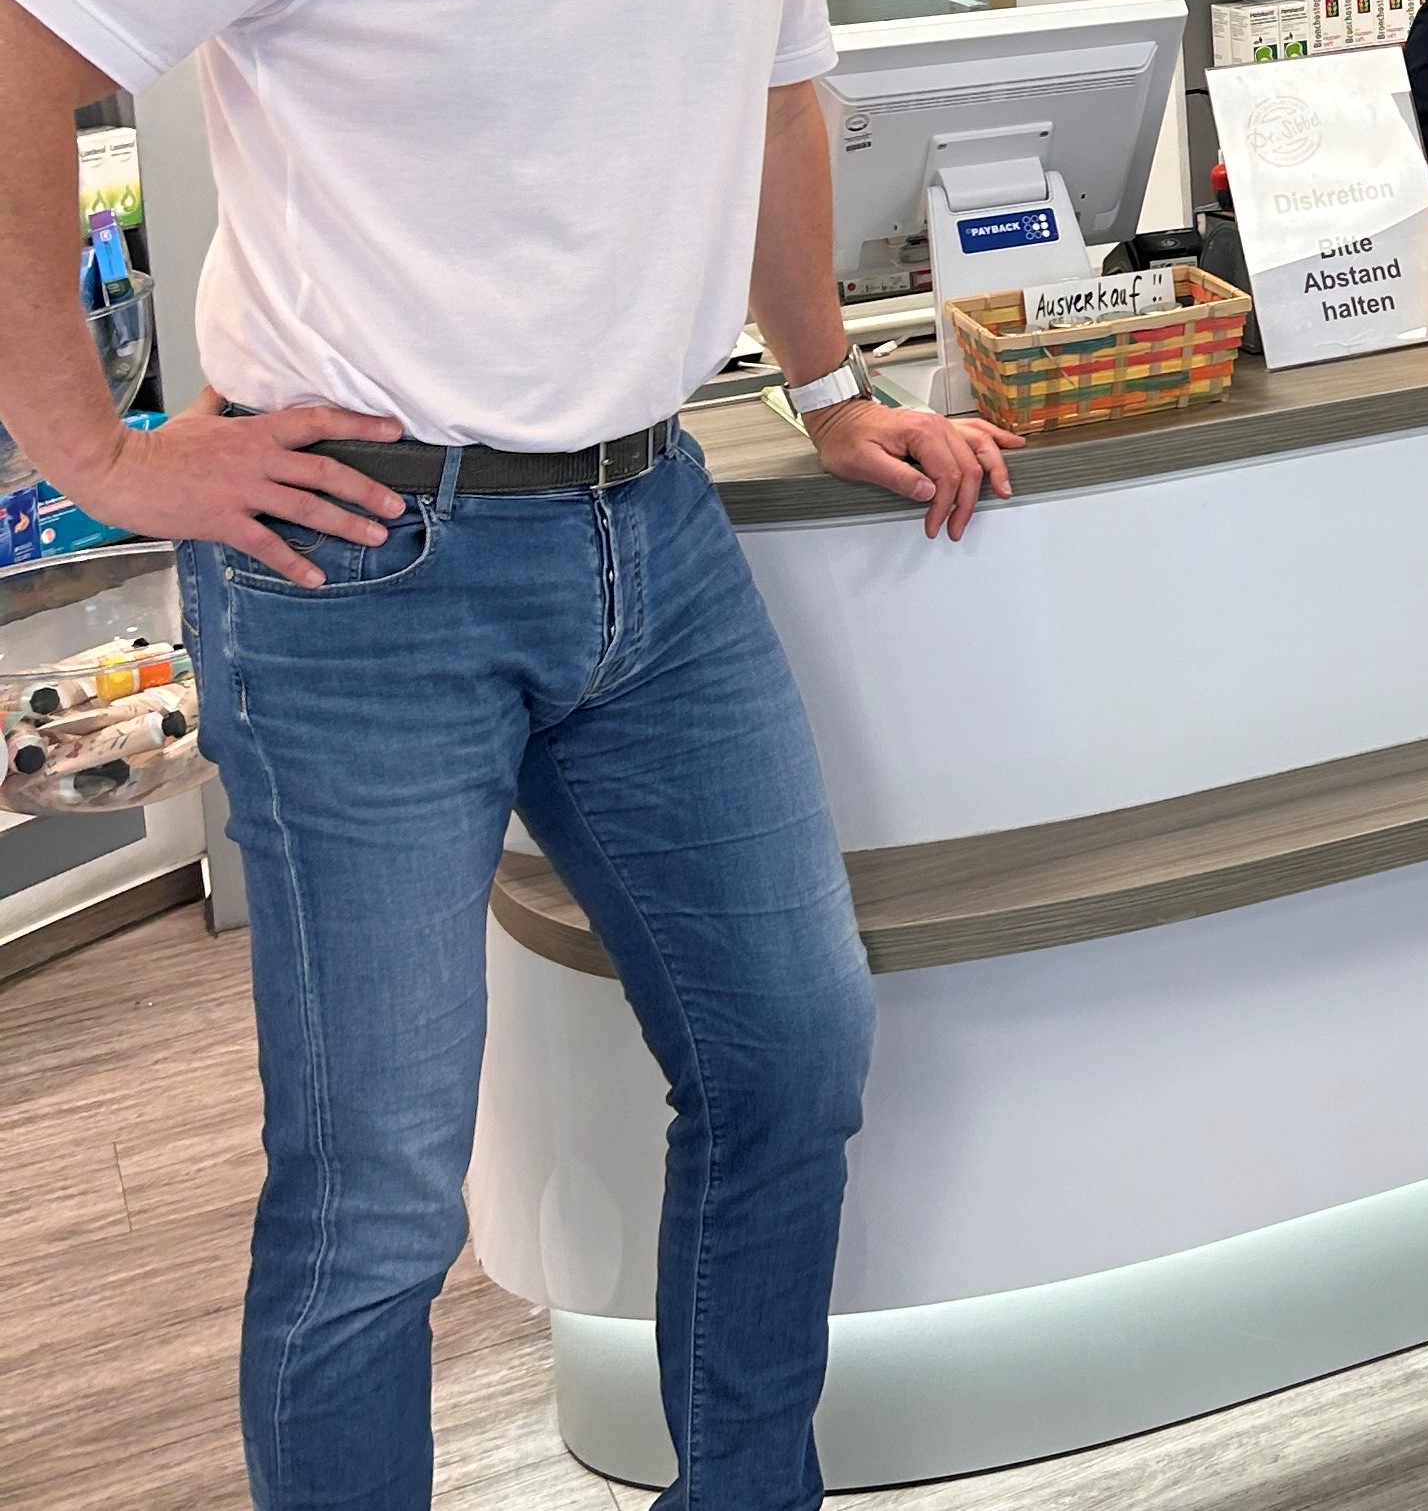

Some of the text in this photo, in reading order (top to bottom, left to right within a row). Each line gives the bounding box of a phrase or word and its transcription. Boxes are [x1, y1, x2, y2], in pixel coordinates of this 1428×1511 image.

[1273, 178, 1395, 215] Diskretion
[971, 221, 1020, 237] PAYBACK
[1318, 235, 1374, 259] Bitte
[1303, 257, 1402, 294] Abstand
[1036, 275, 1142, 320] Ausverkauf
[1322, 292, 1395, 323] halten
